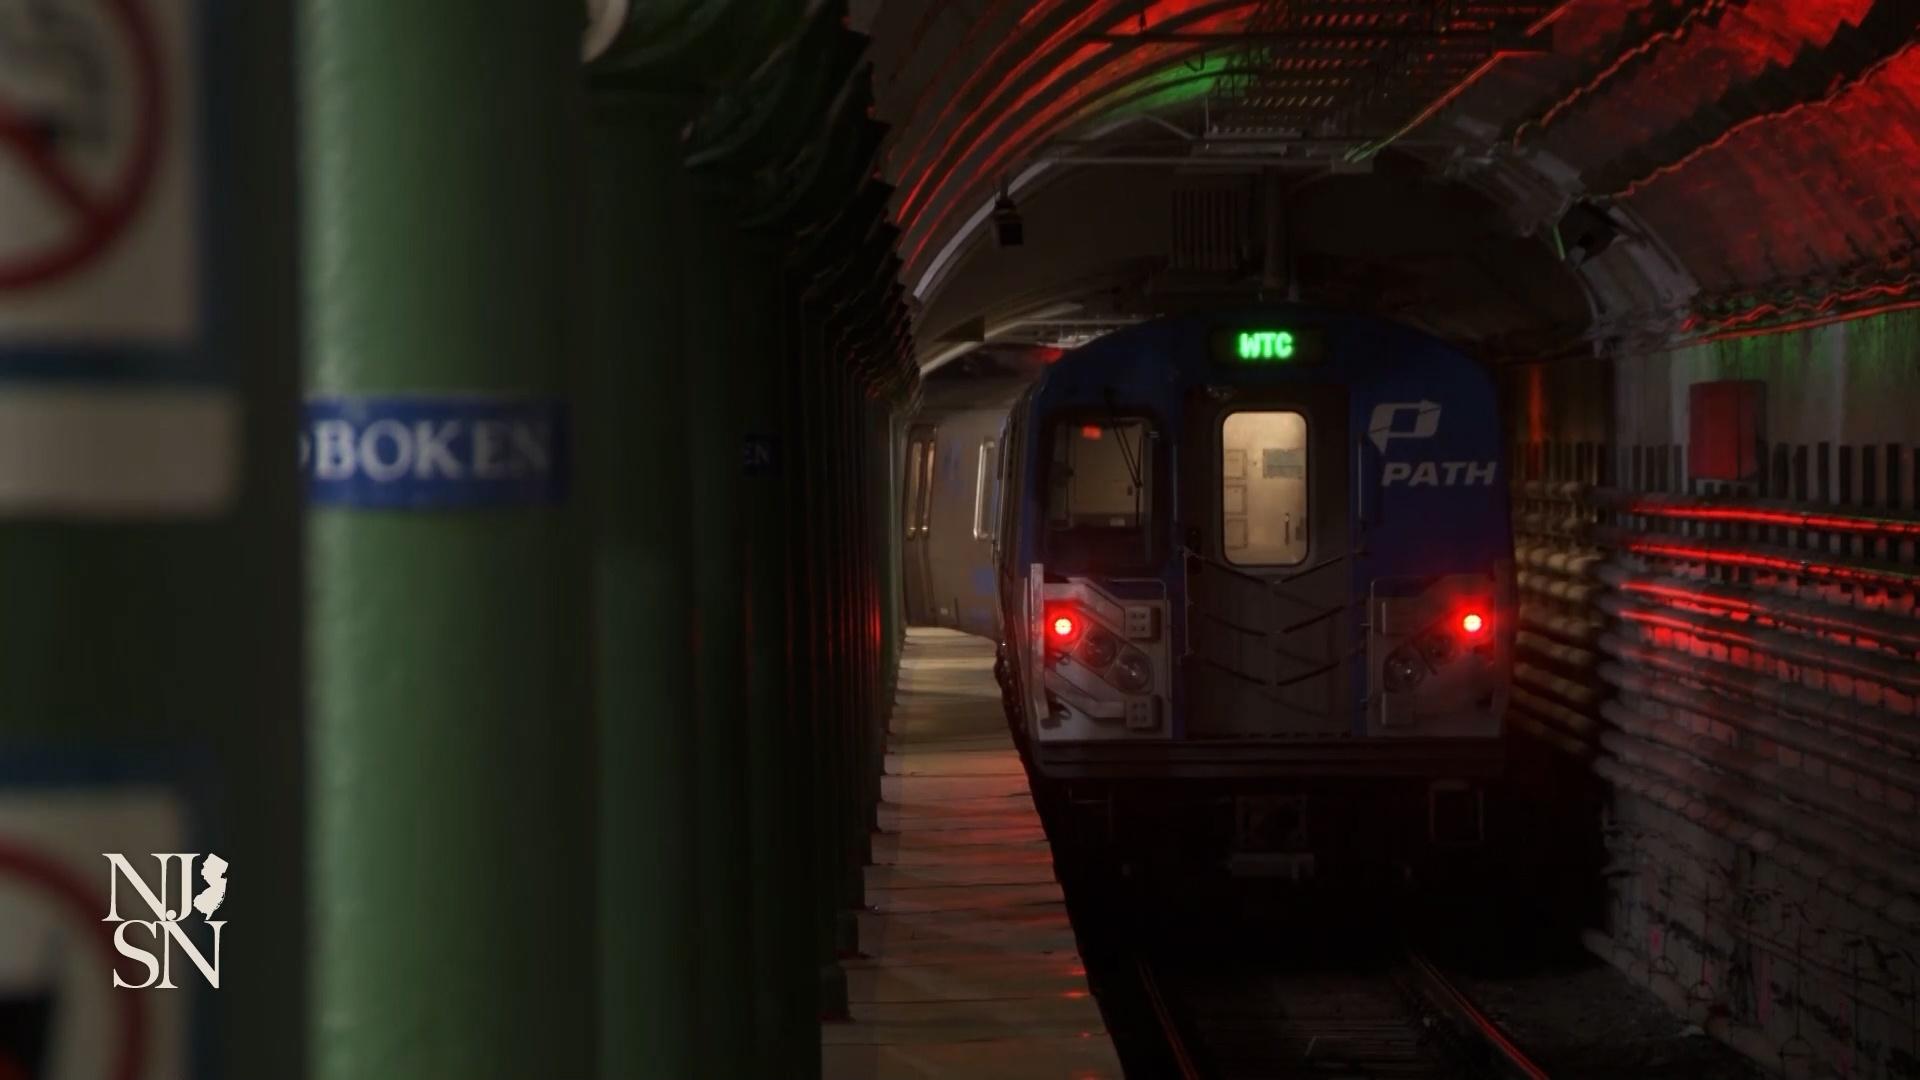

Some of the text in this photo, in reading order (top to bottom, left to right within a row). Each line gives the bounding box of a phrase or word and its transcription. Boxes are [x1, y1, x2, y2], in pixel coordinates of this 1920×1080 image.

[1239, 332, 1292, 358] WTC
[299, 418, 550, 482] BOKEN
[1380, 460, 1497, 487] PATH
